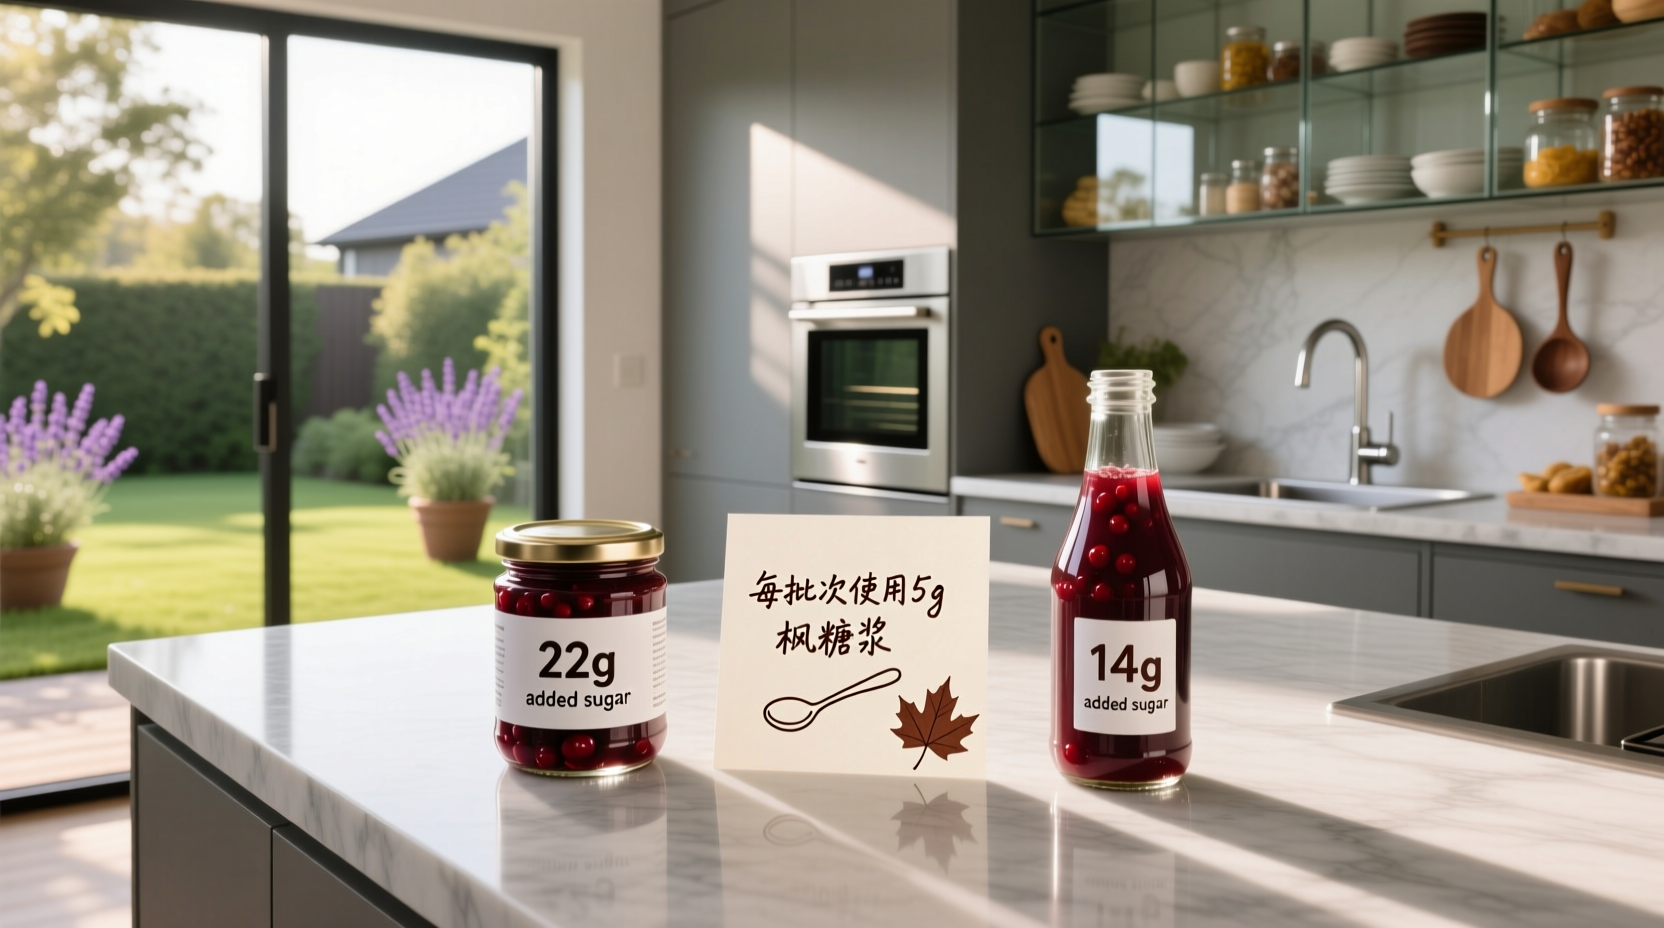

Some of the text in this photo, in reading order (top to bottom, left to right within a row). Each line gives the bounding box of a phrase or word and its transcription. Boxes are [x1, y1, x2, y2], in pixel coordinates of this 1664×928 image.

[748, 570, 945, 618] 每批次使用5g
[775, 616, 892, 658] 枫糖浆
[538, 640, 616, 688] 22g
[1090, 643, 1162, 692] 14g
[525, 690, 631, 711] added sugar
[1084, 695, 1169, 714] added sugar
